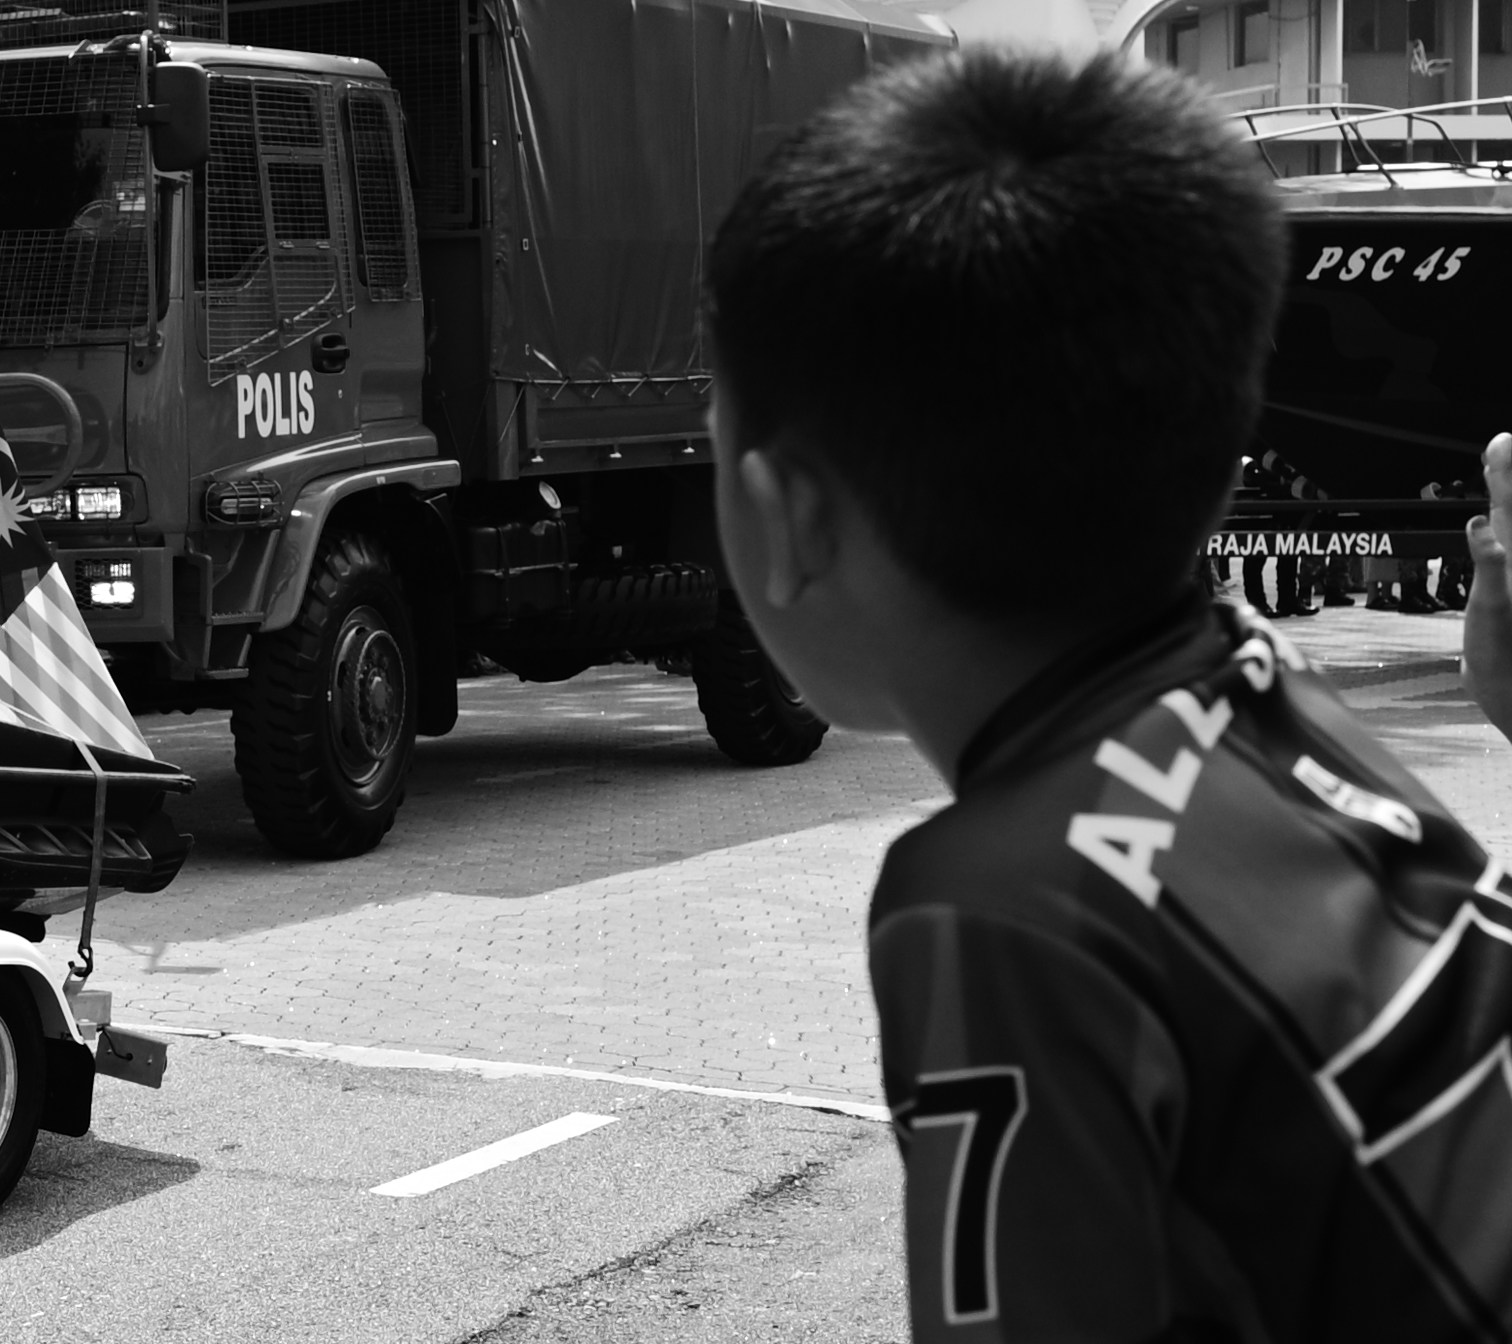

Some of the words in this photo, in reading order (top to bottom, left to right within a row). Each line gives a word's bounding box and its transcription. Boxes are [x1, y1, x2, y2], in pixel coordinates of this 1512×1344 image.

[1306, 246, 1406, 282] PSC
[1413, 246, 1472, 282] 45
[236, 370, 316, 439] POLIS
[1196, 532, 1269, 556] RAJA
[1275, 532, 1394, 556] MALAYSIA
[892, 1065, 1029, 1326] 7
